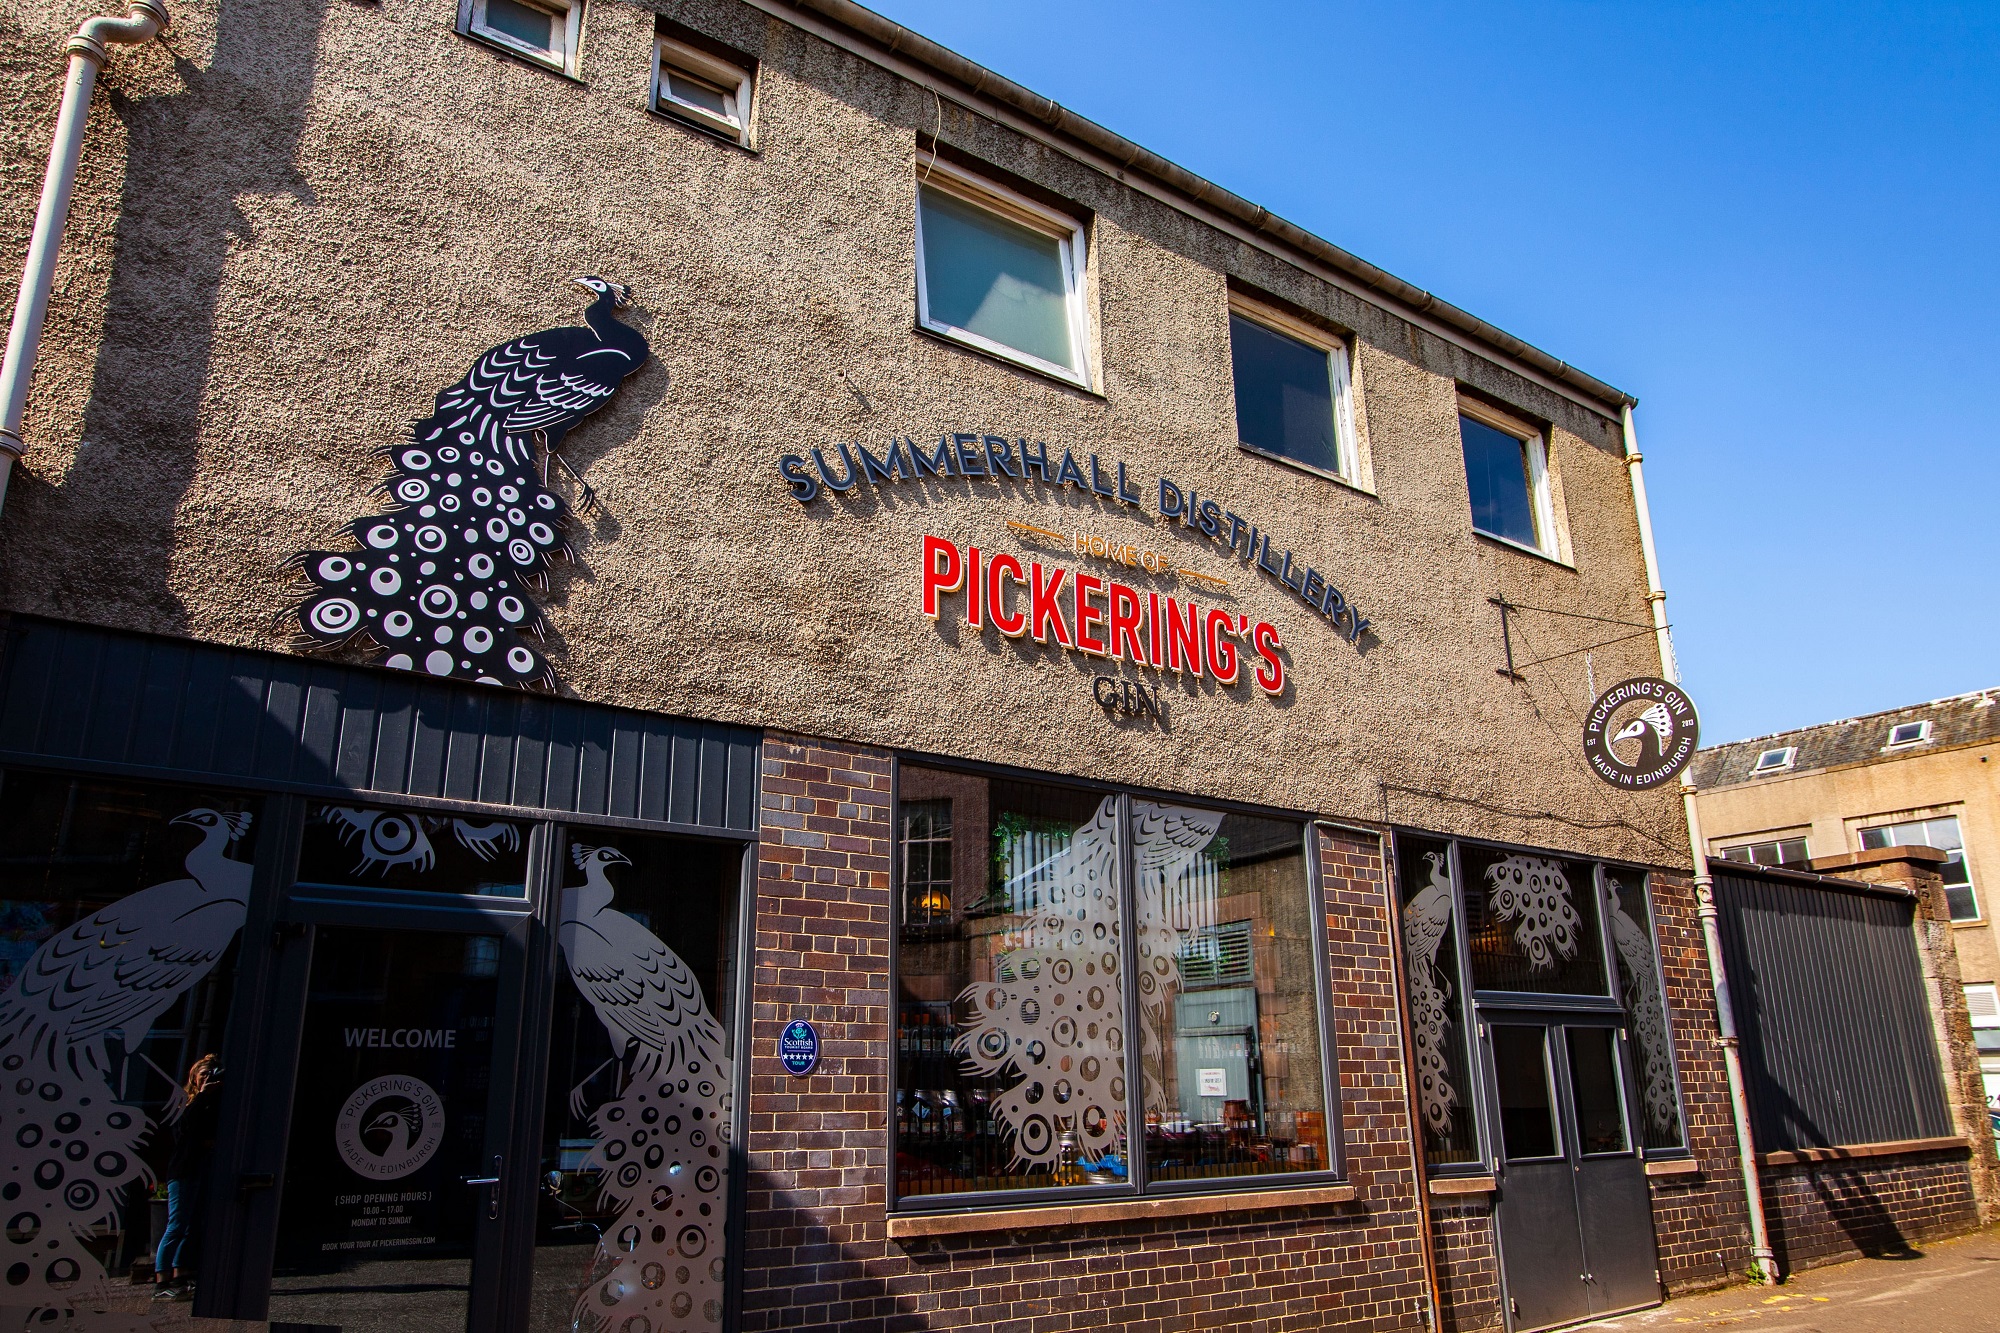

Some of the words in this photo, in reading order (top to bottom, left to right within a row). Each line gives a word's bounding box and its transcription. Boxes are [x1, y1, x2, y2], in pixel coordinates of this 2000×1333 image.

[779, 432, 1139, 503] SUMMERHALL
[1158, 477, 1371, 642] DISTILLERY
[1074, 530, 1138, 567] HOME
[1141, 551, 1169, 574] OF
[922, 534, 1285, 696] PICKERING'S
[1092, 676, 1162, 717] GIN
[1589, 682, 1665, 732] PICKERING'S
[1664, 691, 1687, 715] GIN
[1586, 738, 1596, 746] EST
[1592, 754, 1619, 780] MADE
[1619, 774, 1632, 784] IN
[1636, 736, 1691, 785] EDINBURGH
[344, 1028, 456, 1048] WELCOME
[784, 1038, 813, 1046] Scottish
[346, 1080, 423, 1117] PICKERING'S
[421, 1094, 439, 1117] GIN
[342, 1139, 364, 1165] MADE
[365, 1162, 377, 1172] IN
[380, 1136, 436, 1174] EDINBURGH
[340, 1194, 362, 1205] SHOP
[364, 1193, 399, 1203] OPENING
[401, 1191, 427, 1202] HOURS
[351, 1218, 377, 1227] MONDAY
[379, 1217, 387, 1226] TO
[388, 1216, 413, 1225] SUNDAY
[321, 1242, 338, 1251] BOOK
[339, 1241, 355, 1250] YOUR
[356, 1240, 371, 1249] TOUR
[372, 1240, 379, 1248] AT
